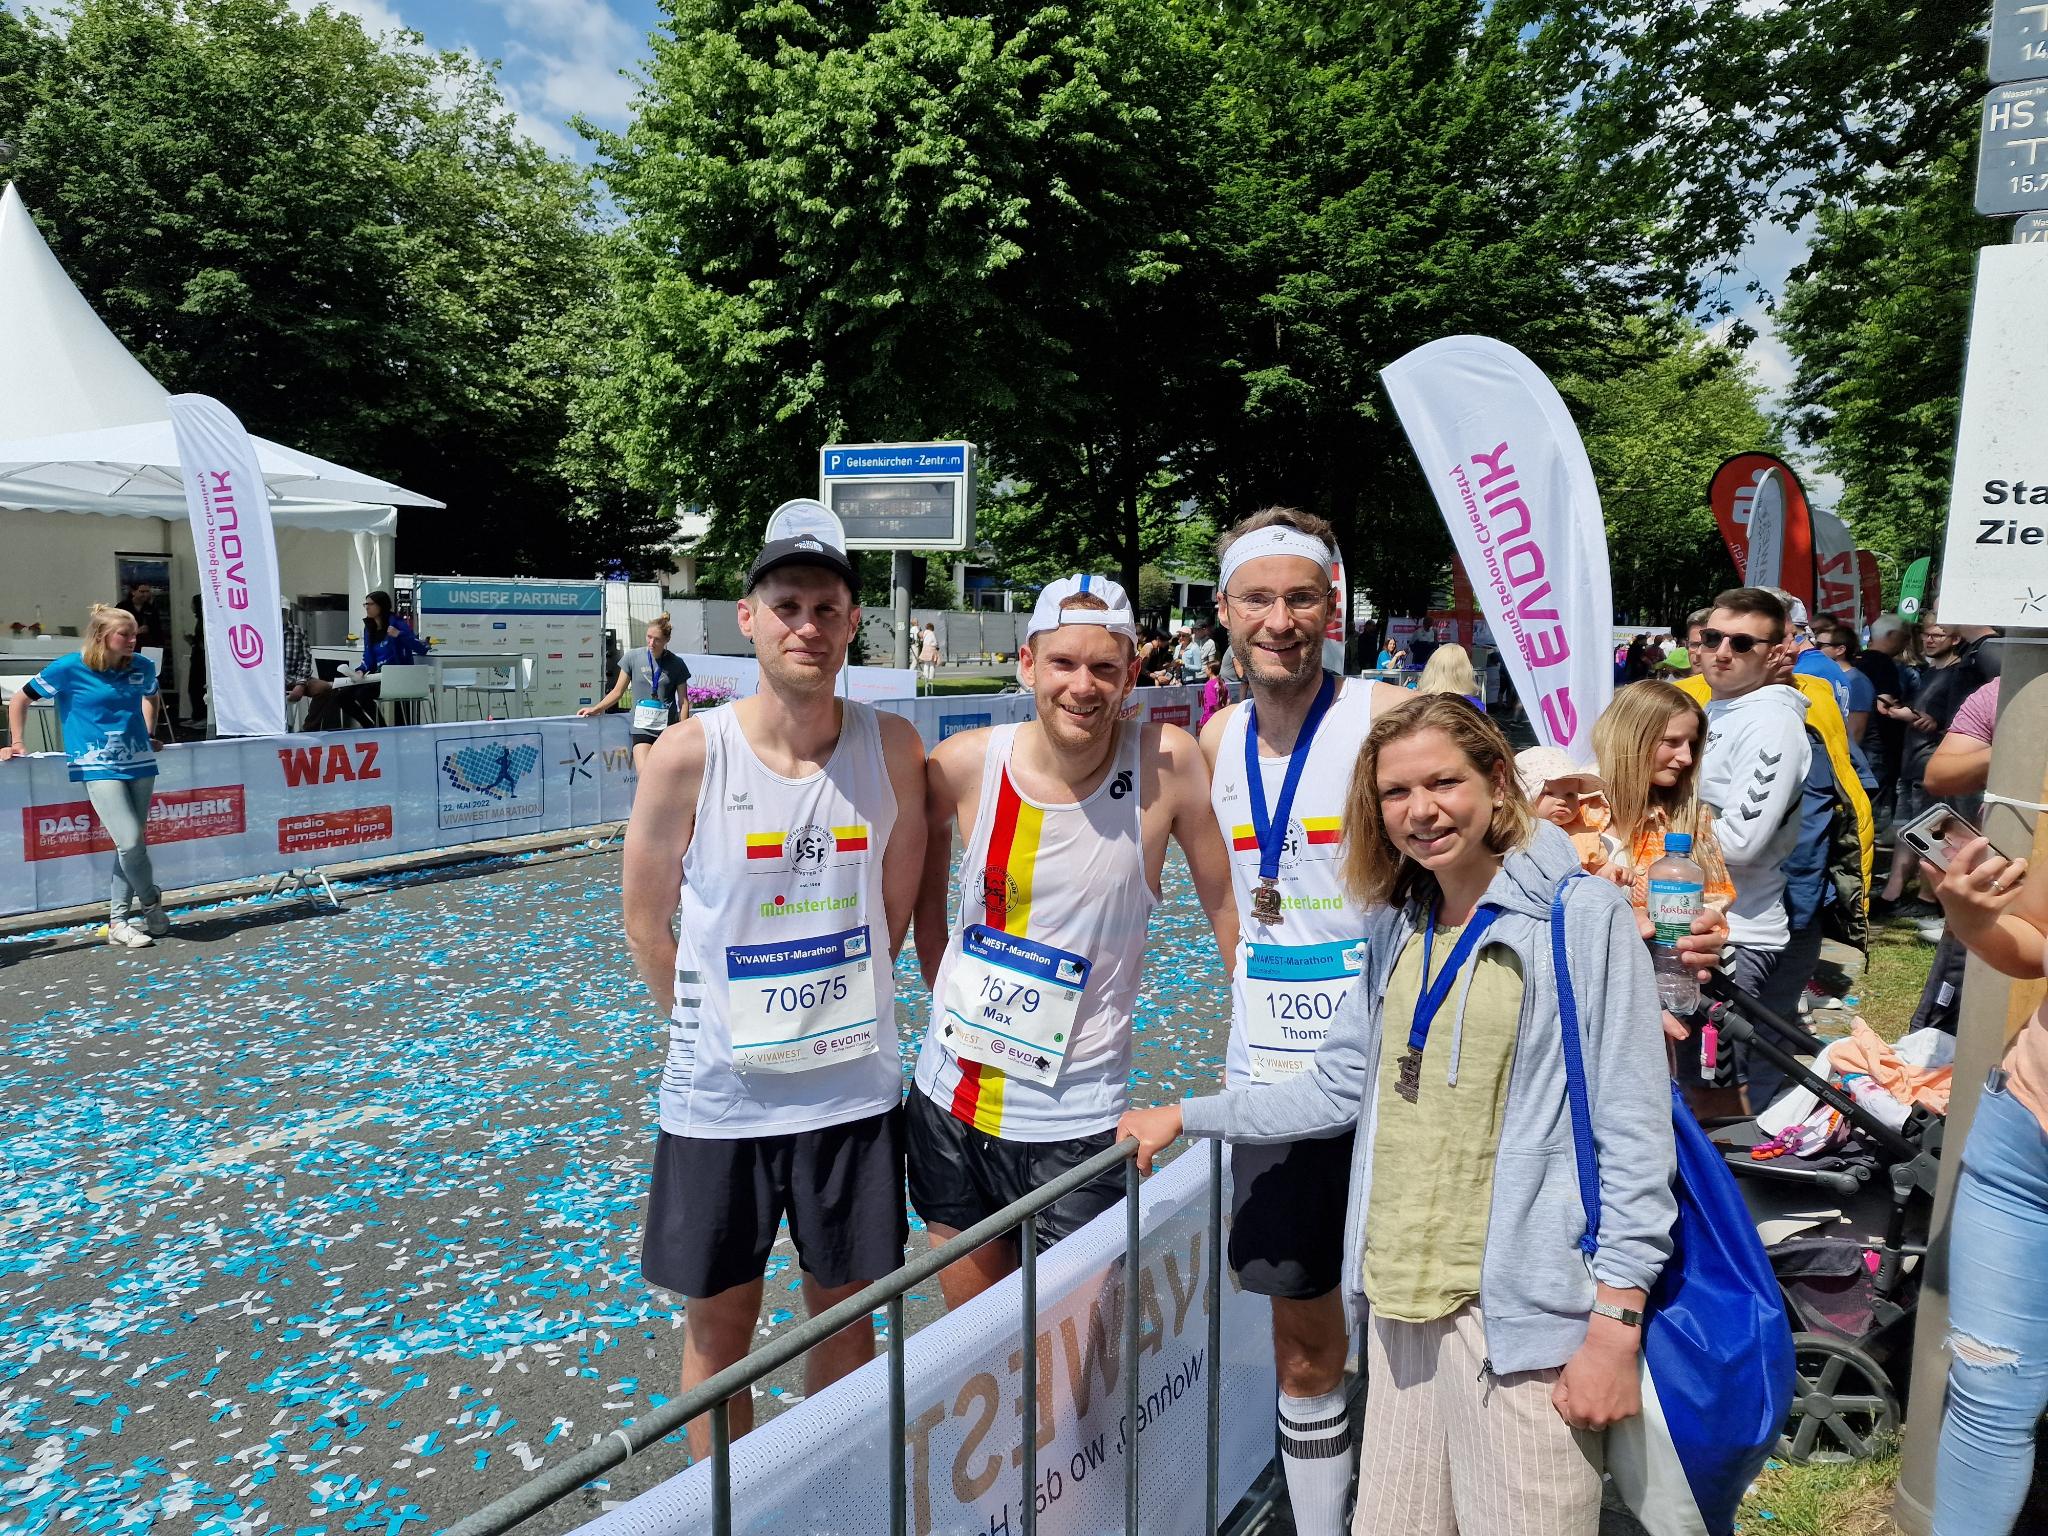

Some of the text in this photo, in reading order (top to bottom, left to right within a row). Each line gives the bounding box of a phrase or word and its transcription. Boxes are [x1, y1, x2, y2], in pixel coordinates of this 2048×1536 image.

[2022, 40, 2048, 60] 14
[2003, 89, 2033, 98] Wasser
[1990, 101, 2035, 131] HS
[832, 453, 961, 470] P Gelsenkirchen -Zentrum
[1976, 519, 2048, 545] Zie
[449, 591, 578, 605] UNSERE PARTNER
[1904, 600, 1915, 611] A
[278, 742, 381, 787] WAZ
[443, 804, 542, 825] VIVAWEST MARATHON
[456, 802, 471, 810] MAI
[472, 800, 490, 808] 2022
[727, 804, 754, 812] erima
[39, 814, 91, 835] DAS
[286, 817, 325, 831] radio
[286, 822, 386, 843] emscher lippe
[1281, 894, 1344, 911] sterland
[735, 944, 838, 965] VIVAWEST-Marathon
[760, 975, 848, 1014] 70675
[979, 975, 1041, 1013] 1679
[983, 1006, 1013, 1026] Max
[757, 1049, 801, 1063] VIVAWEST
[830, 1031, 871, 1048] EVONIK
[1266, 1058, 1303, 1070] VIVAWEST
